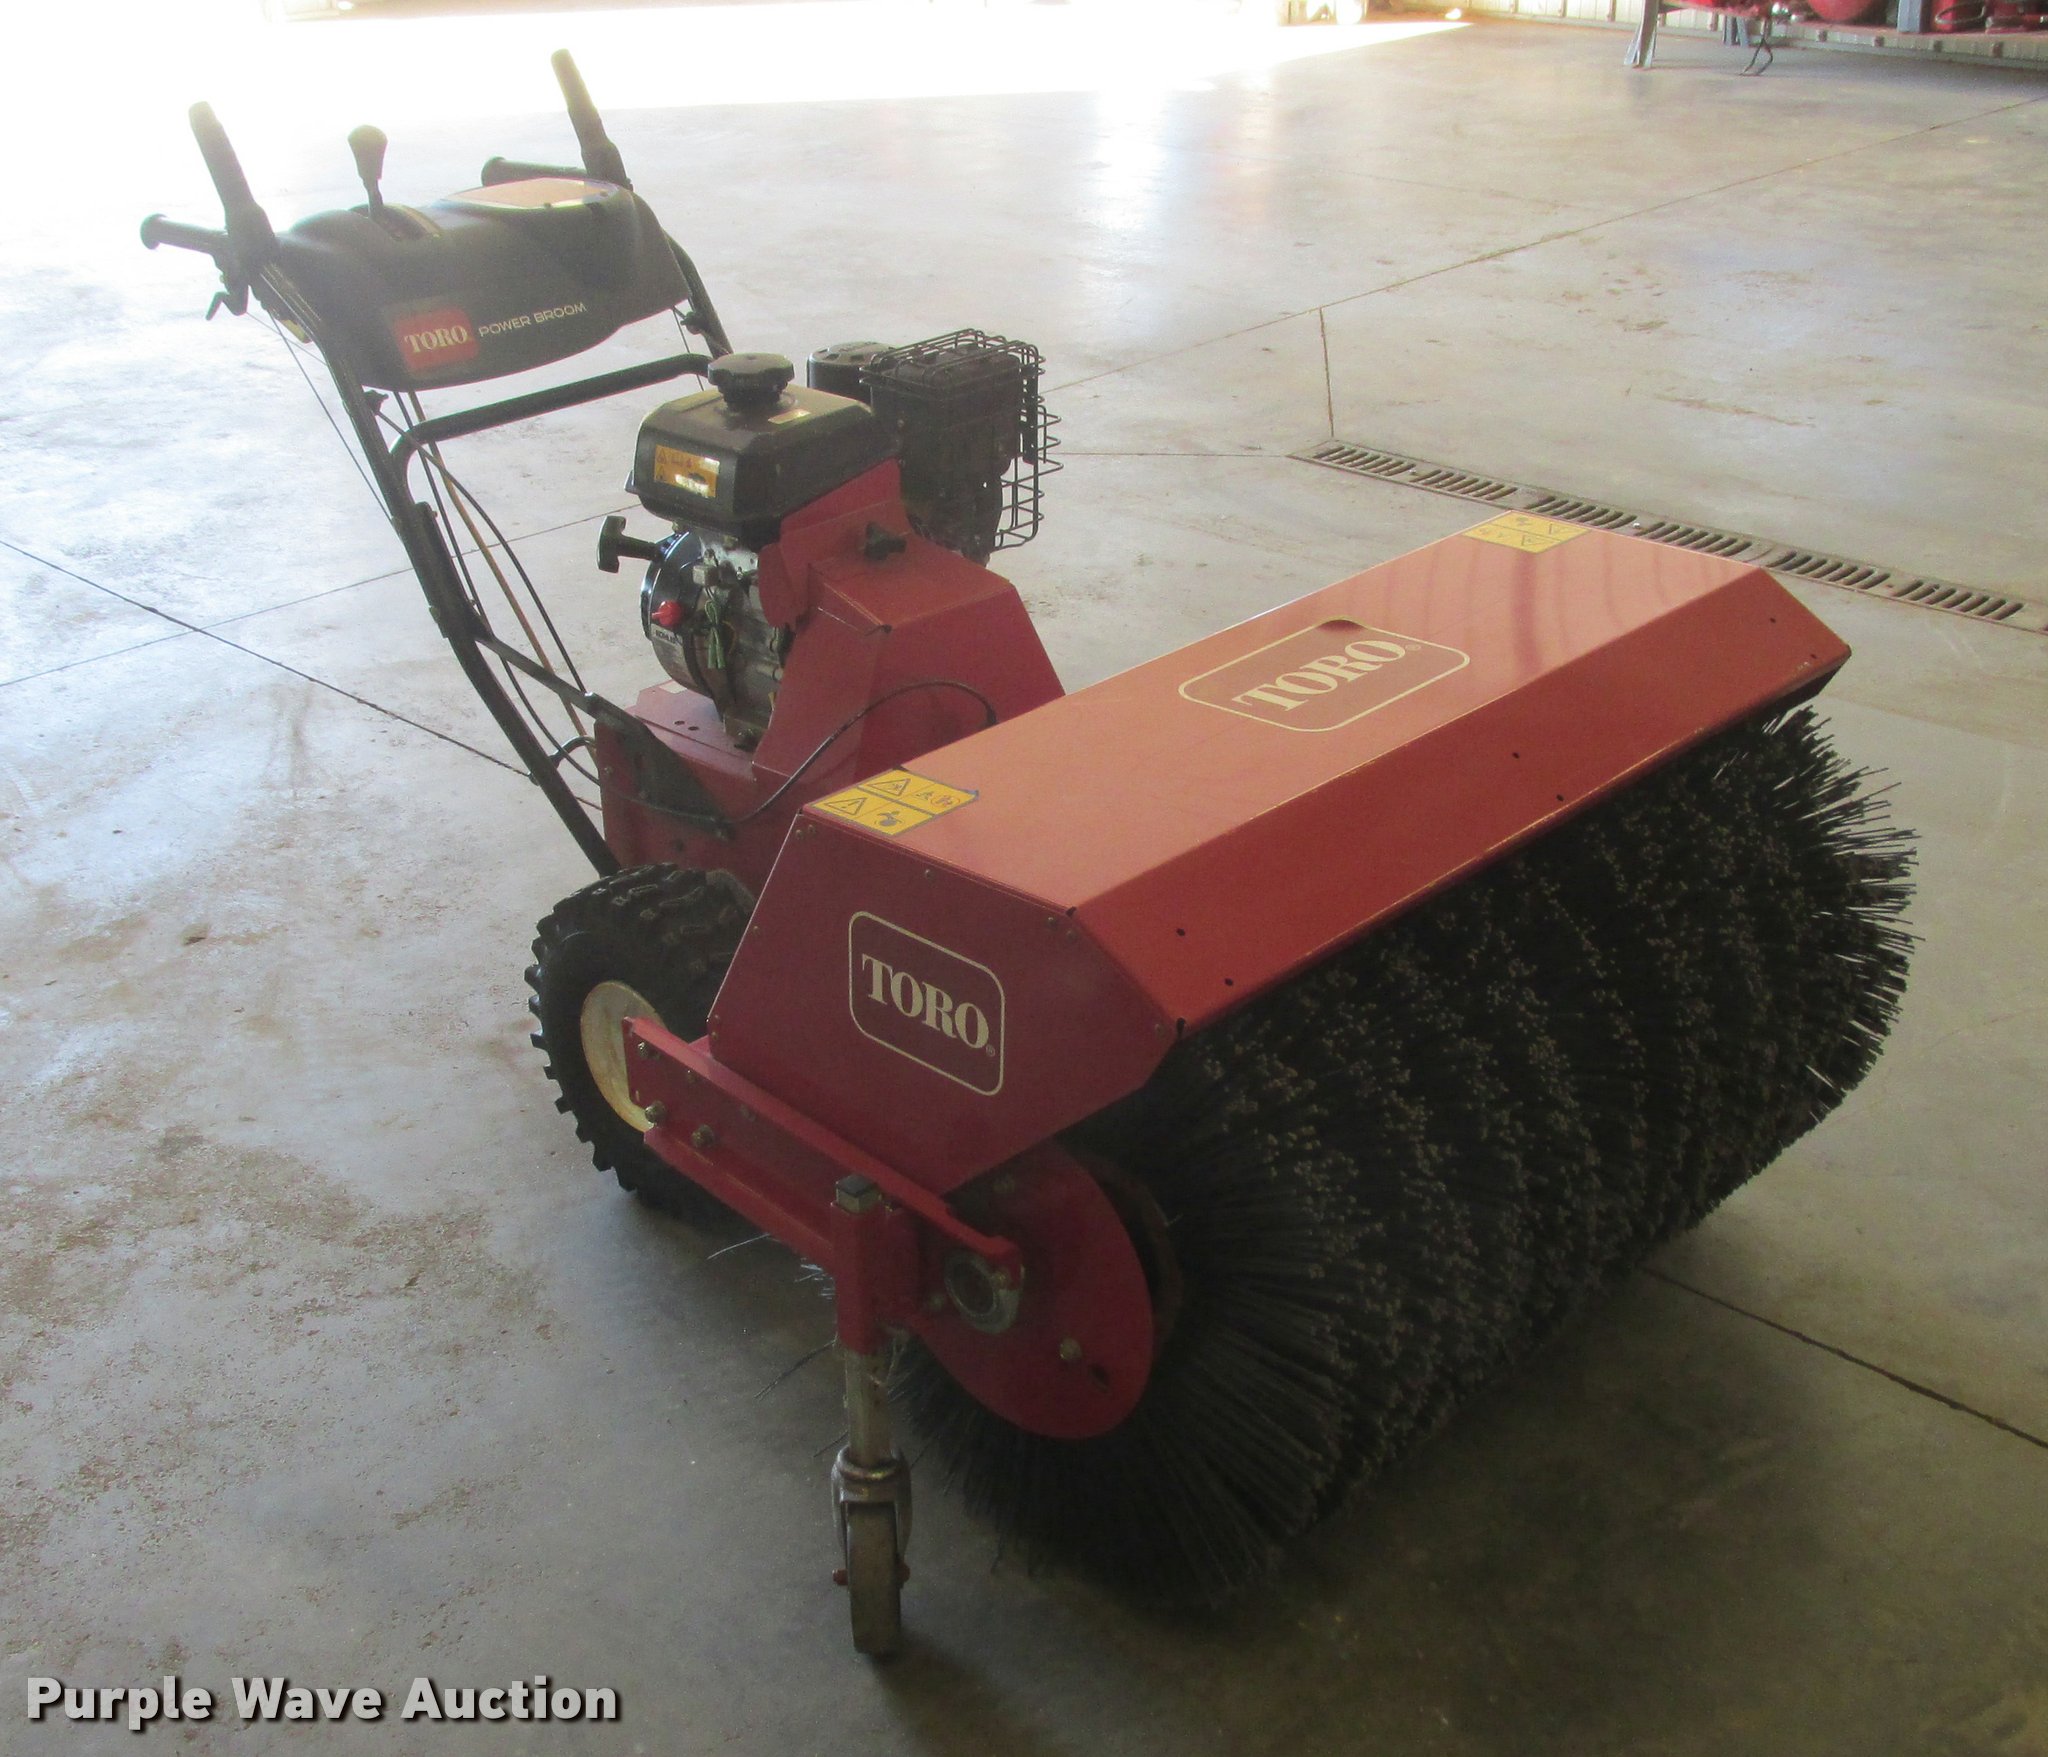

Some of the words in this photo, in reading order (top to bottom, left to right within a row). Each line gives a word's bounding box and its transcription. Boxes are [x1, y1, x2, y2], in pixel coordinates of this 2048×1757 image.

[404, 325, 469, 353] TORO
[478, 315, 532, 337] POWER
[533, 302, 588, 322] BROOM
[1232, 640, 1405, 711] TORO
